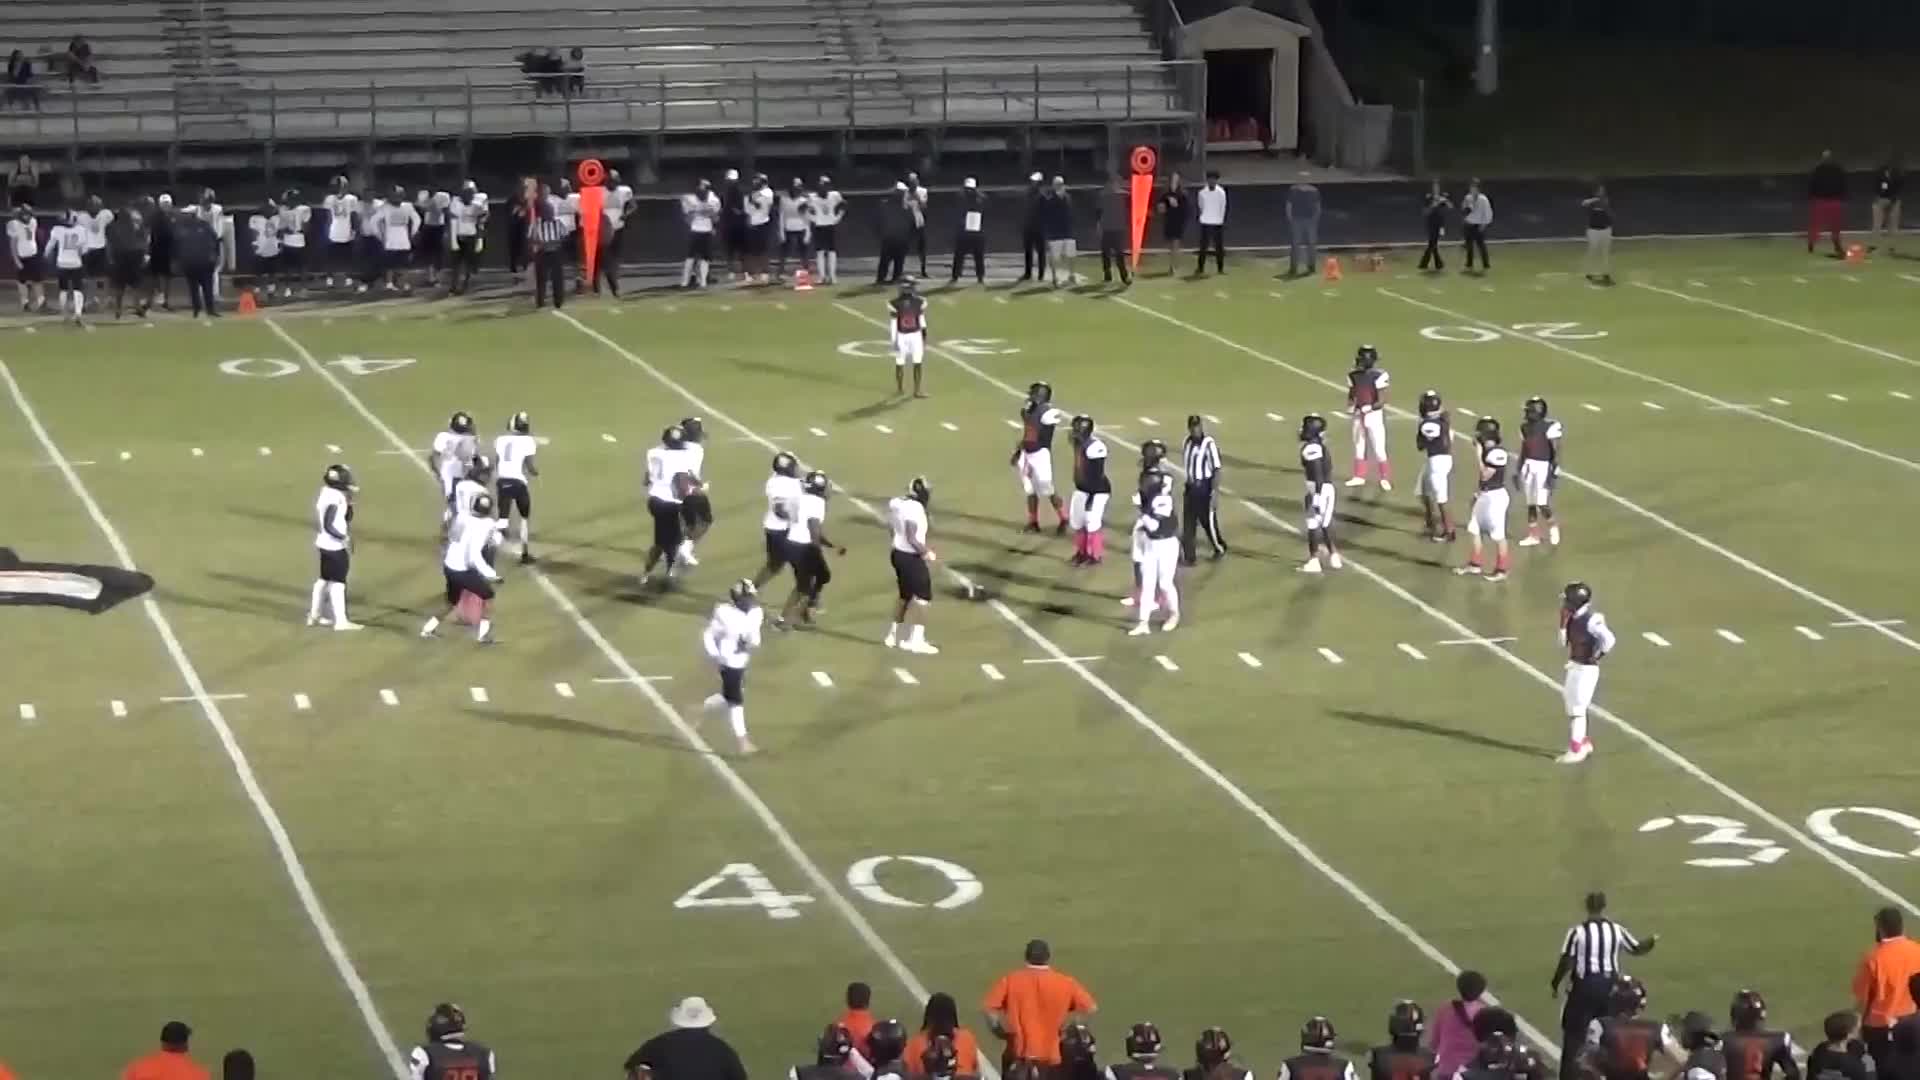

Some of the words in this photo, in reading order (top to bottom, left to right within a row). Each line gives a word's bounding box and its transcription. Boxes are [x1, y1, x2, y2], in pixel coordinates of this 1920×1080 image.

[1419, 322, 1609, 342] 20
[218, 354, 417, 377] 40
[1637, 806, 1920, 868] 30
[673, 855, 984, 920] 40
